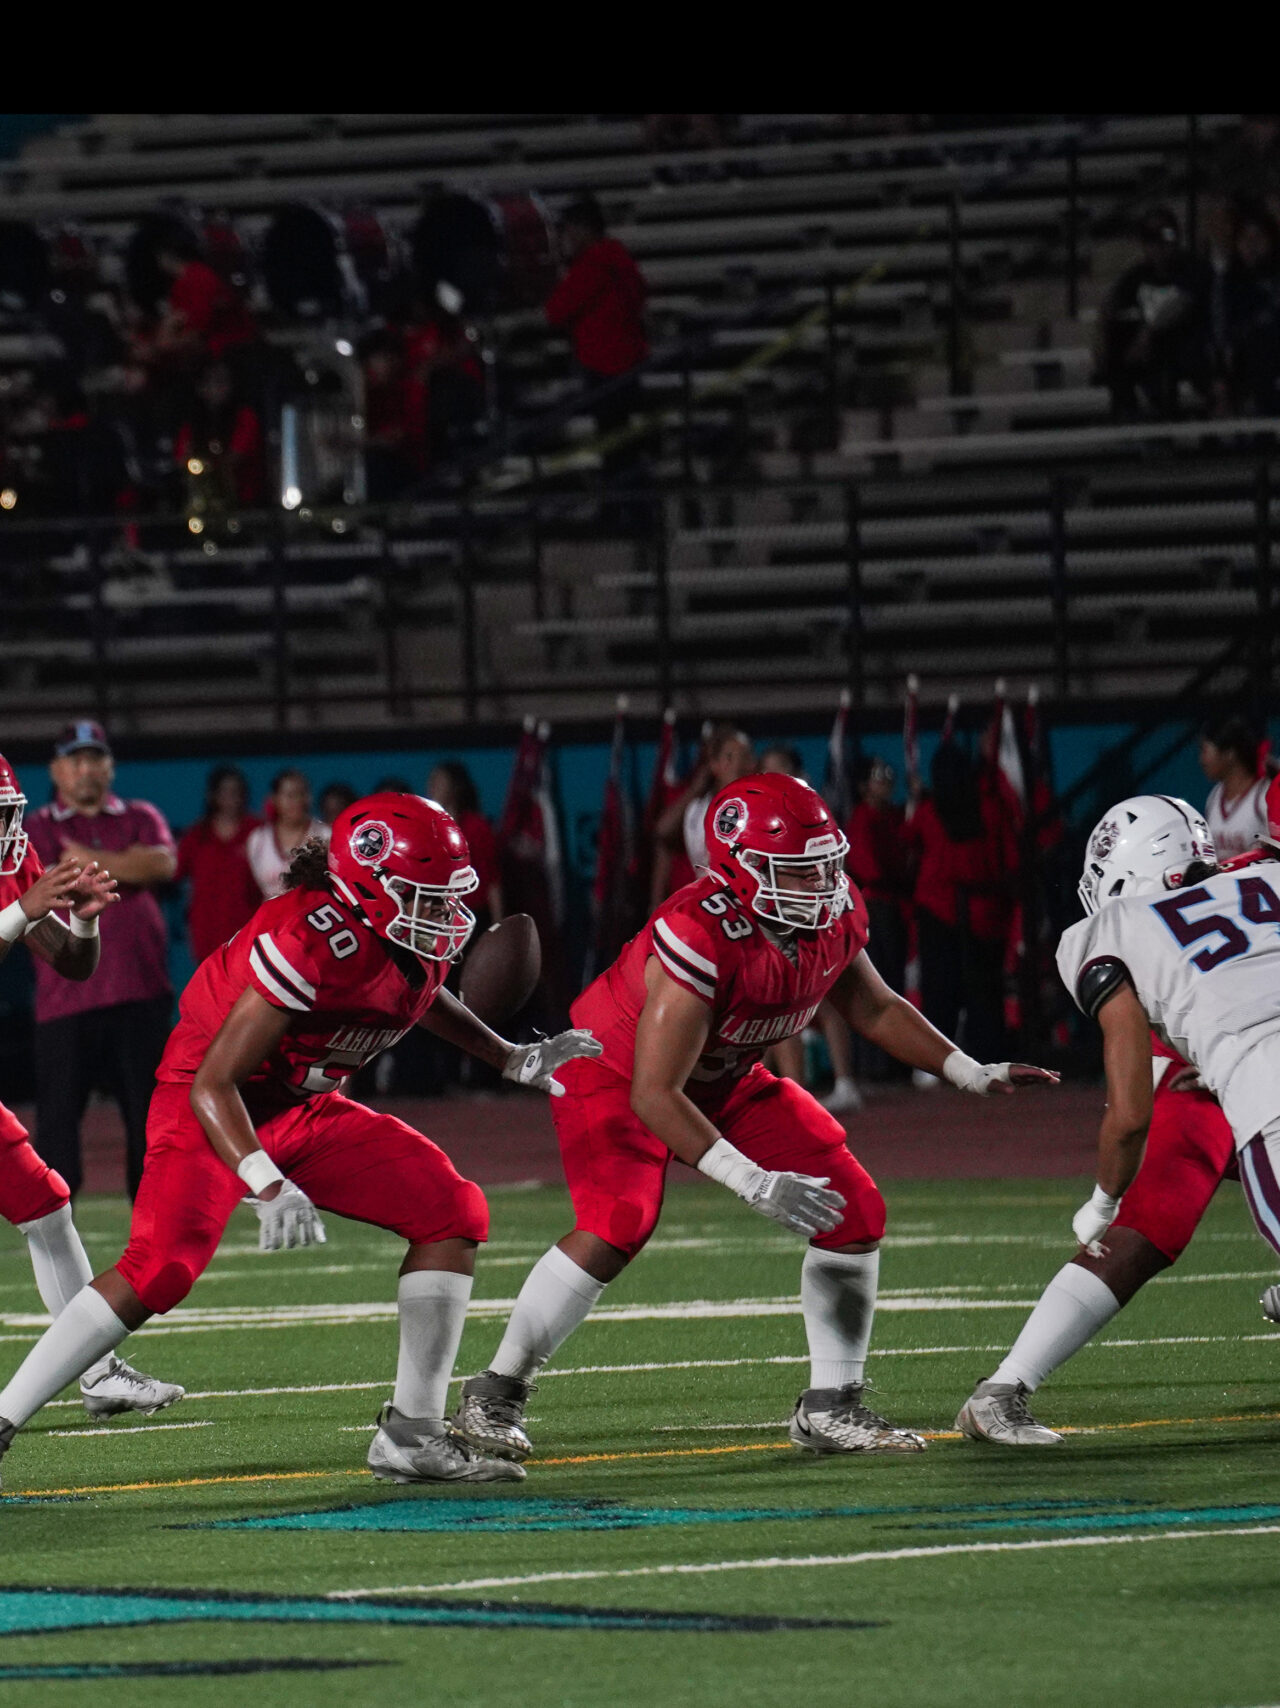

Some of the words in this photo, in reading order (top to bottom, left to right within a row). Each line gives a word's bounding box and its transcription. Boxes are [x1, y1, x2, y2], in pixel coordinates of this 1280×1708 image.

[306, 903, 359, 960] 50
[700, 892, 753, 940] 53
[1148, 876, 1280, 975] 54
